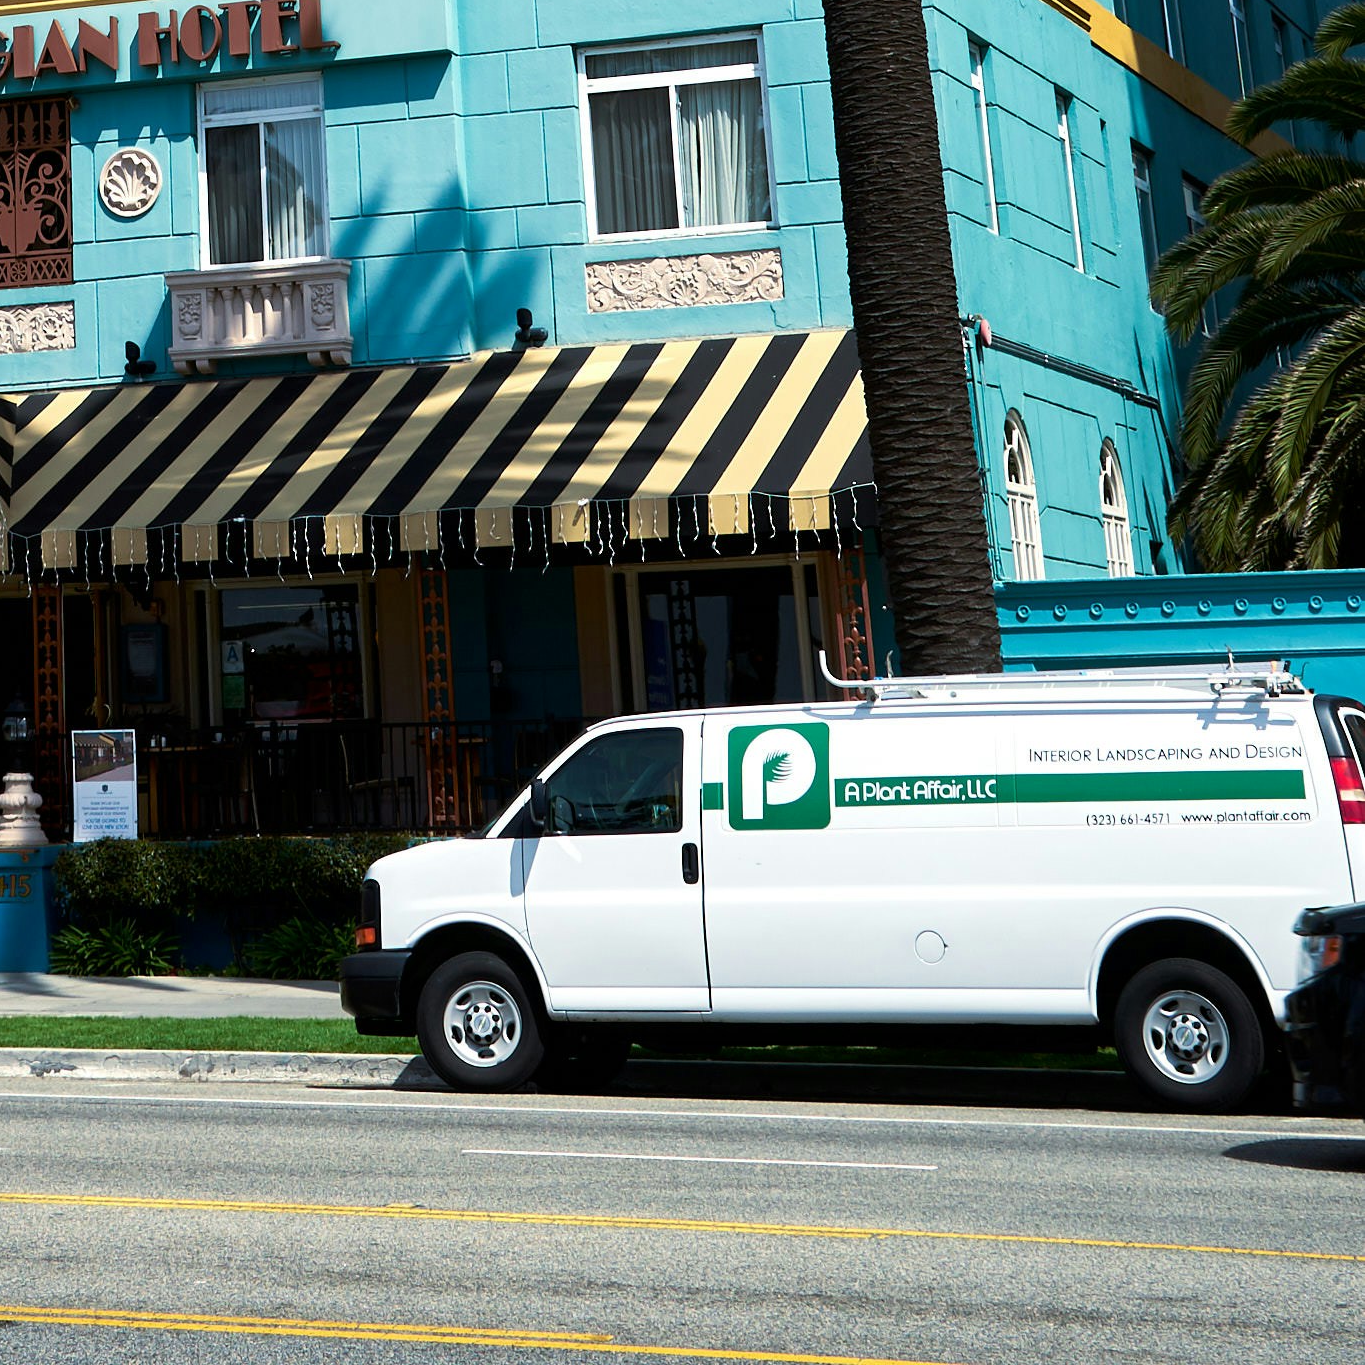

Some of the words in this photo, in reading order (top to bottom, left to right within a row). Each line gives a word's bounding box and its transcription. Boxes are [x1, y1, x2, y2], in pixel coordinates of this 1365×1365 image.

[226, 645, 239, 662] A
[844, 781, 860, 802] A
[862, 780, 912, 802] Plant
[1086, 813, 1116, 826] (323)
[1120, 812, 1170, 825] 661-4571
[1180, 810, 1311, 824] www.plantaffair.com
